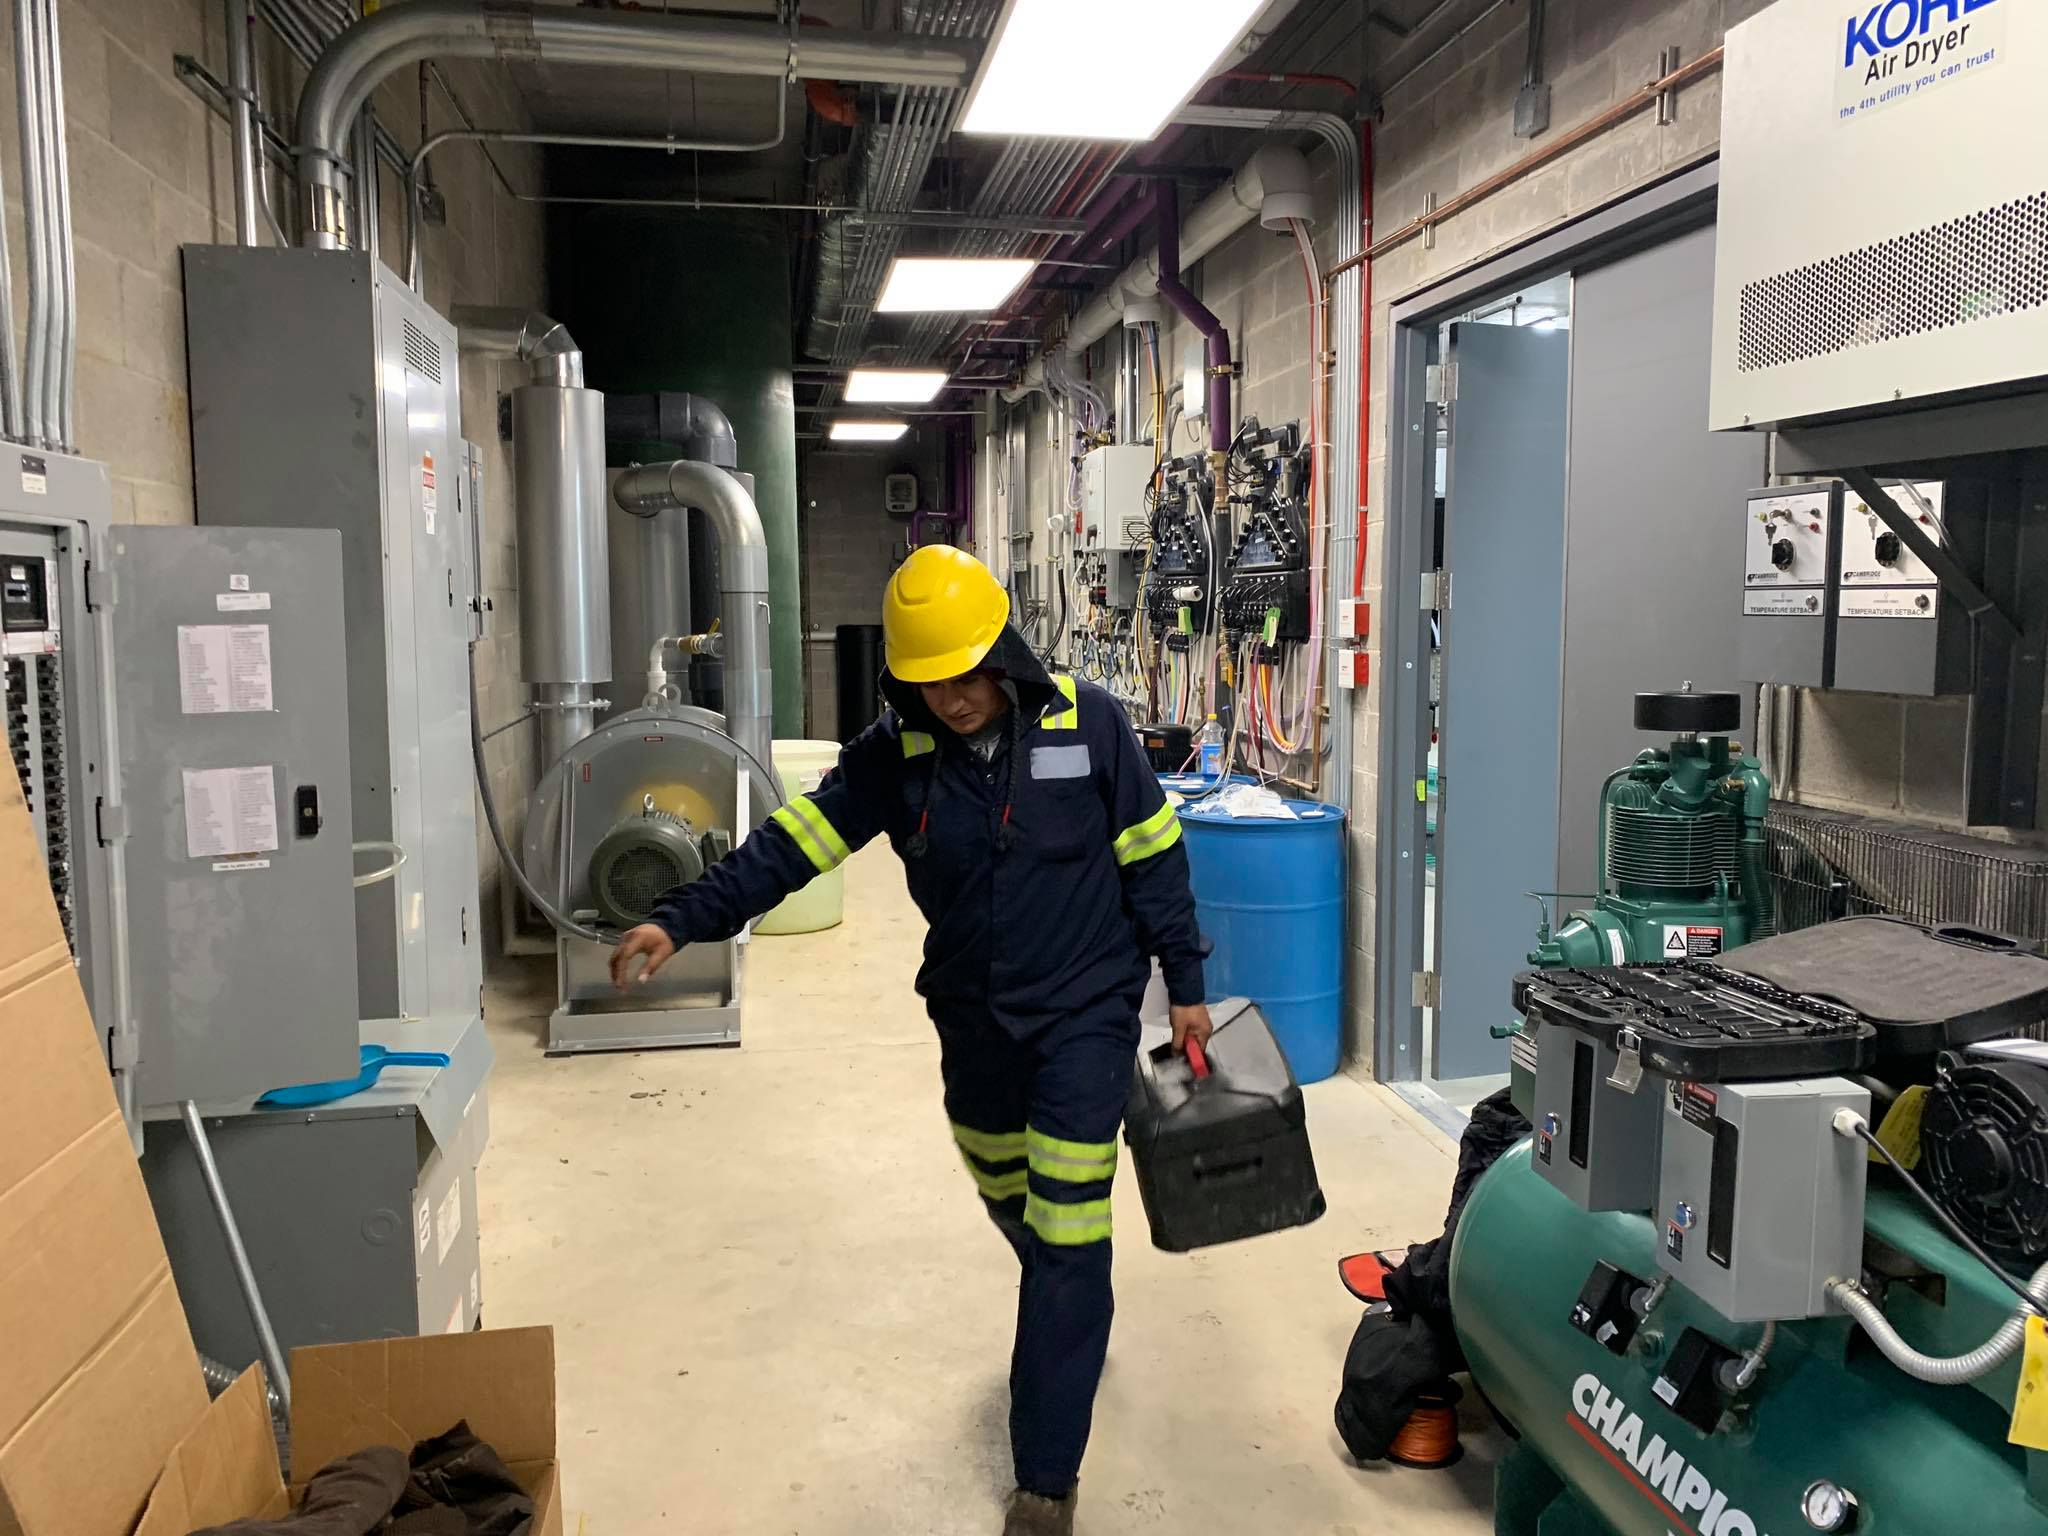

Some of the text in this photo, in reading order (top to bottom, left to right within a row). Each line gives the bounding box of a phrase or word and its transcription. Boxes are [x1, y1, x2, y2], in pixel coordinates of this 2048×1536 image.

[1844, 0, 1998, 68] KOH
[1864, 24, 1970, 85] Air Dryer
[1839, 48, 1995, 119] the 4th utility you can trust
[1750, 606, 1788, 614] TEMPERATURE
[1572, 1373, 1770, 1536] CHAMPIO
